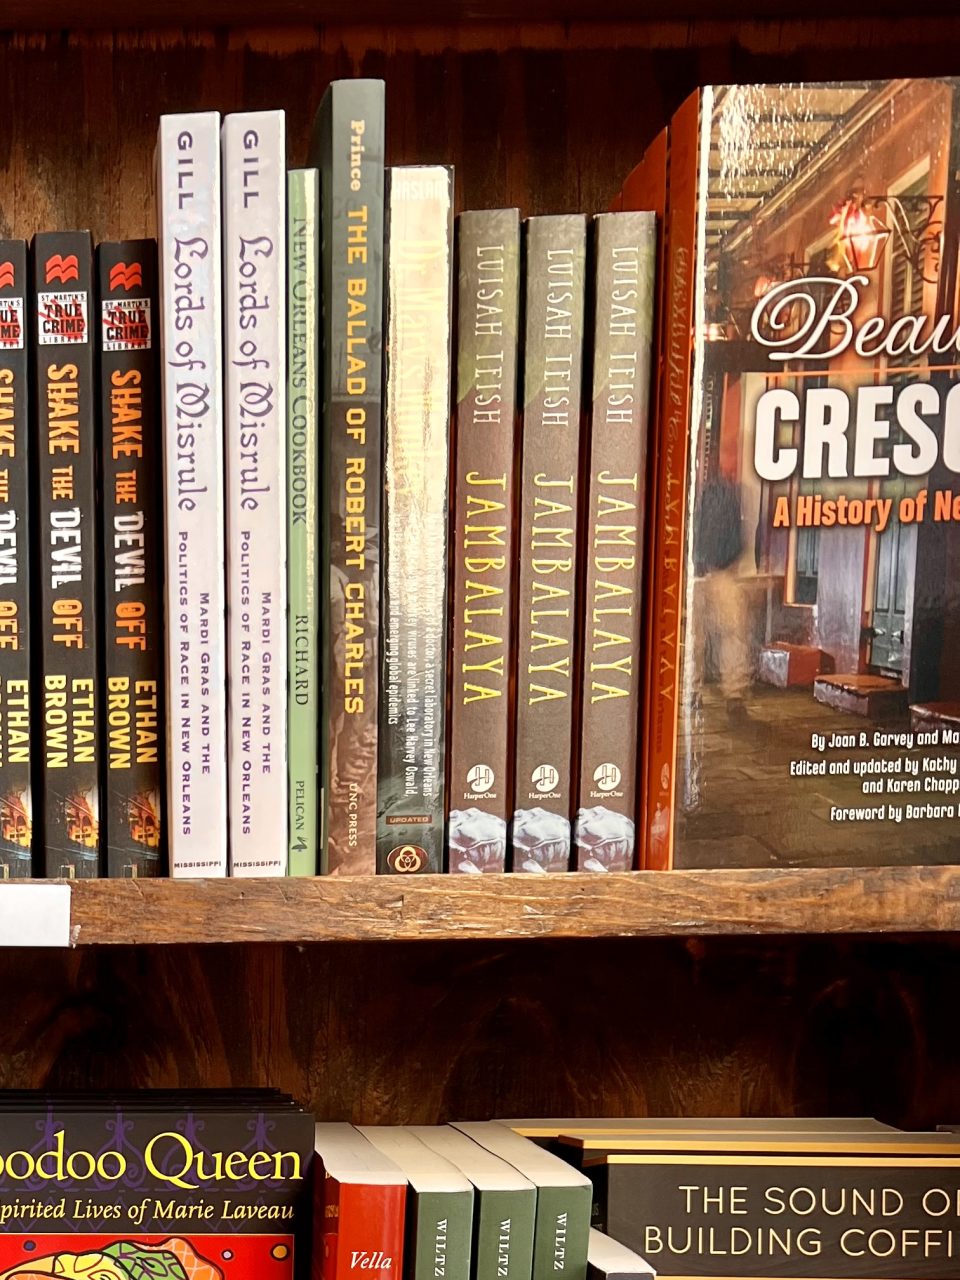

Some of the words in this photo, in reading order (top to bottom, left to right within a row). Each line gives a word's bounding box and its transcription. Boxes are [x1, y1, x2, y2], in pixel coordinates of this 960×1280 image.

[177, 131, 194, 209] GILL
[350, 120, 365, 191] Prince
[348, 206, 367, 264] THE
[175, 237, 208, 330] Lords
[475, 245, 504, 336] LUISAH
[168, 342, 206, 370] of
[347, 279, 367, 395] BALLAD
[473, 350, 504, 424] TEISH
[176, 383, 210, 510] Misrule
[346, 408, 366, 445] OF
[346, 458, 366, 570] ROBERT
[462, 471, 507, 705] JAMBALAYA
[345, 582, 364, 714] CHARLES
[7, 680, 29, 762] ETHAN
[145, 1131, 303, 1189] Queen
[73, 1199, 121, 1220] Lives
[127, 1199, 148, 1224] of
[153, 1199, 214, 1220] Marie
[221, 1199, 294, 1219] Laveau
[678, 1186, 747, 1214] THE
[765, 1187, 903, 1216] SOUND
[350, 1252, 392, 1269] Vella
[435, 1219, 447, 1276] WILTZ
[645, 1226, 821, 1255] BUILDING
